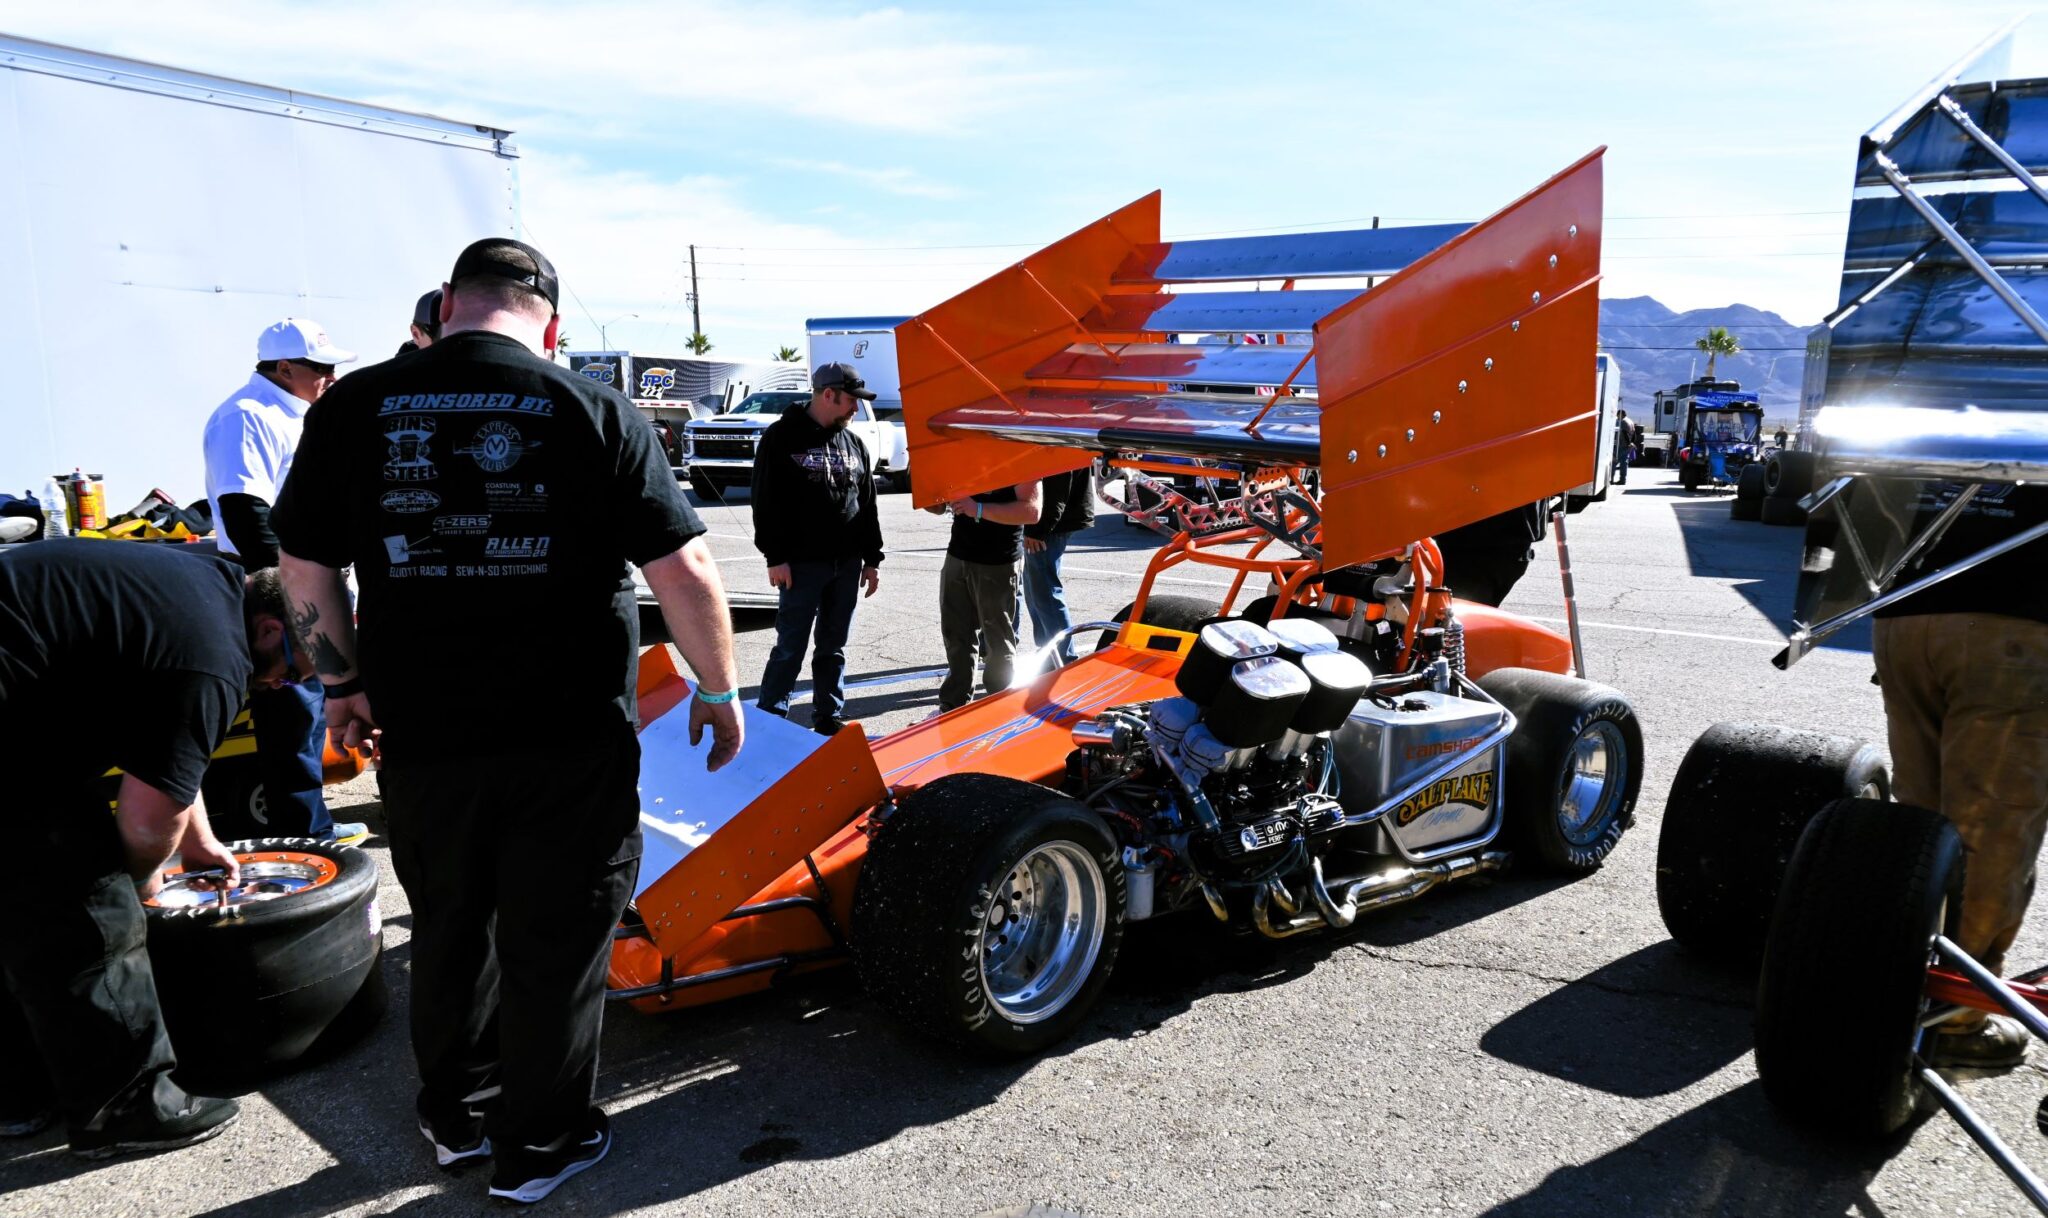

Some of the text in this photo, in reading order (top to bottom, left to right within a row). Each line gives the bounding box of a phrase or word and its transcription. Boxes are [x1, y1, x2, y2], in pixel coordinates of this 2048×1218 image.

[642, 374, 674, 389] IPC
[380, 393, 554, 413] SPONSORED BY:
[383, 416, 436, 434] BINS
[476, 421, 521, 440] EXPRESS
[383, 463, 438, 481] STEEL
[438, 517, 488, 527] T-ZERS
[486, 536, 550, 549] ALLEN
[389, 563, 548, 578] ELLIOTT RACING SEW-N-SO STITCHING
[1397, 770, 1494, 827] SALT LAKE
